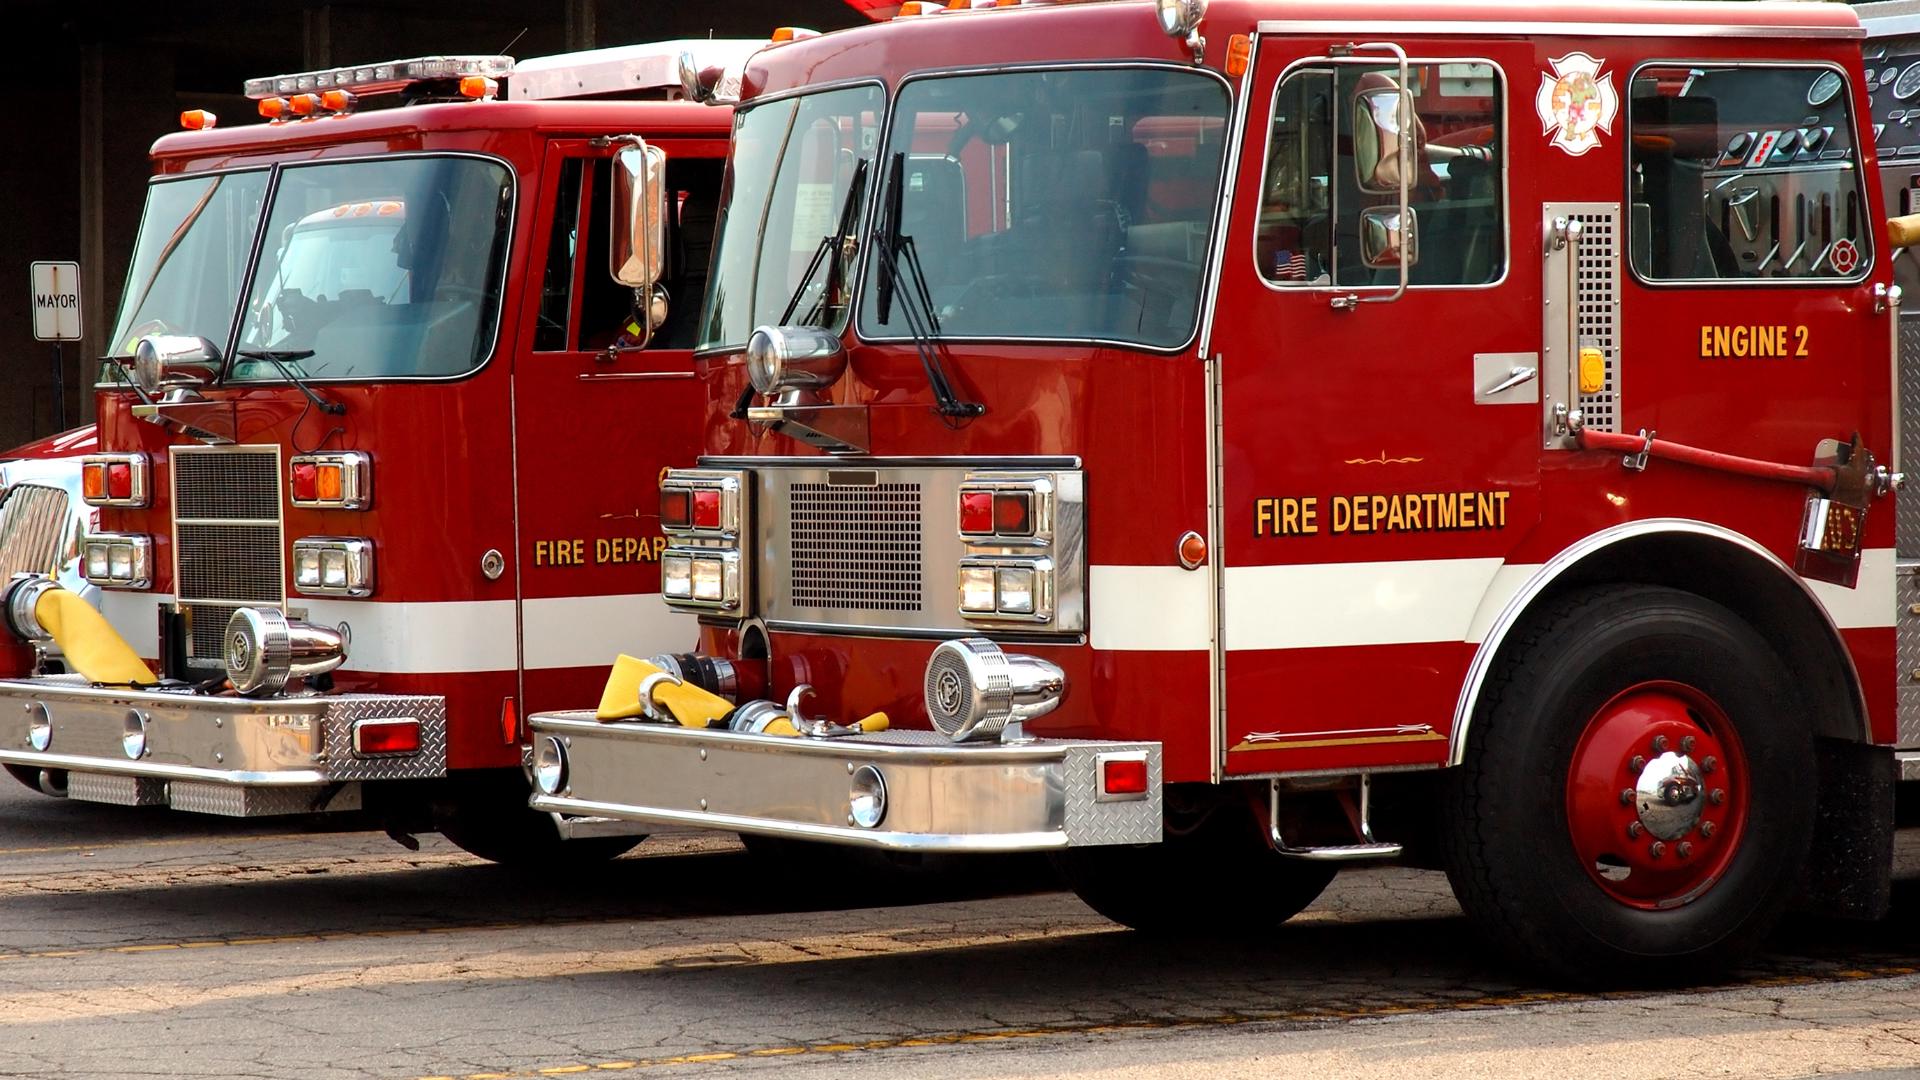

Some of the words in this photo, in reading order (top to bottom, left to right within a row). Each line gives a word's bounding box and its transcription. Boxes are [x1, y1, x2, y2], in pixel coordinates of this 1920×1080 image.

[37, 294, 76, 309] MAYOR
[1700, 325, 1788, 357] ENGINE
[1794, 324, 1809, 357] 2
[1256, 497, 1319, 535] FIRE
[1332, 491, 1510, 533] DEPARTMENT
[535, 539, 585, 566] FIRE
